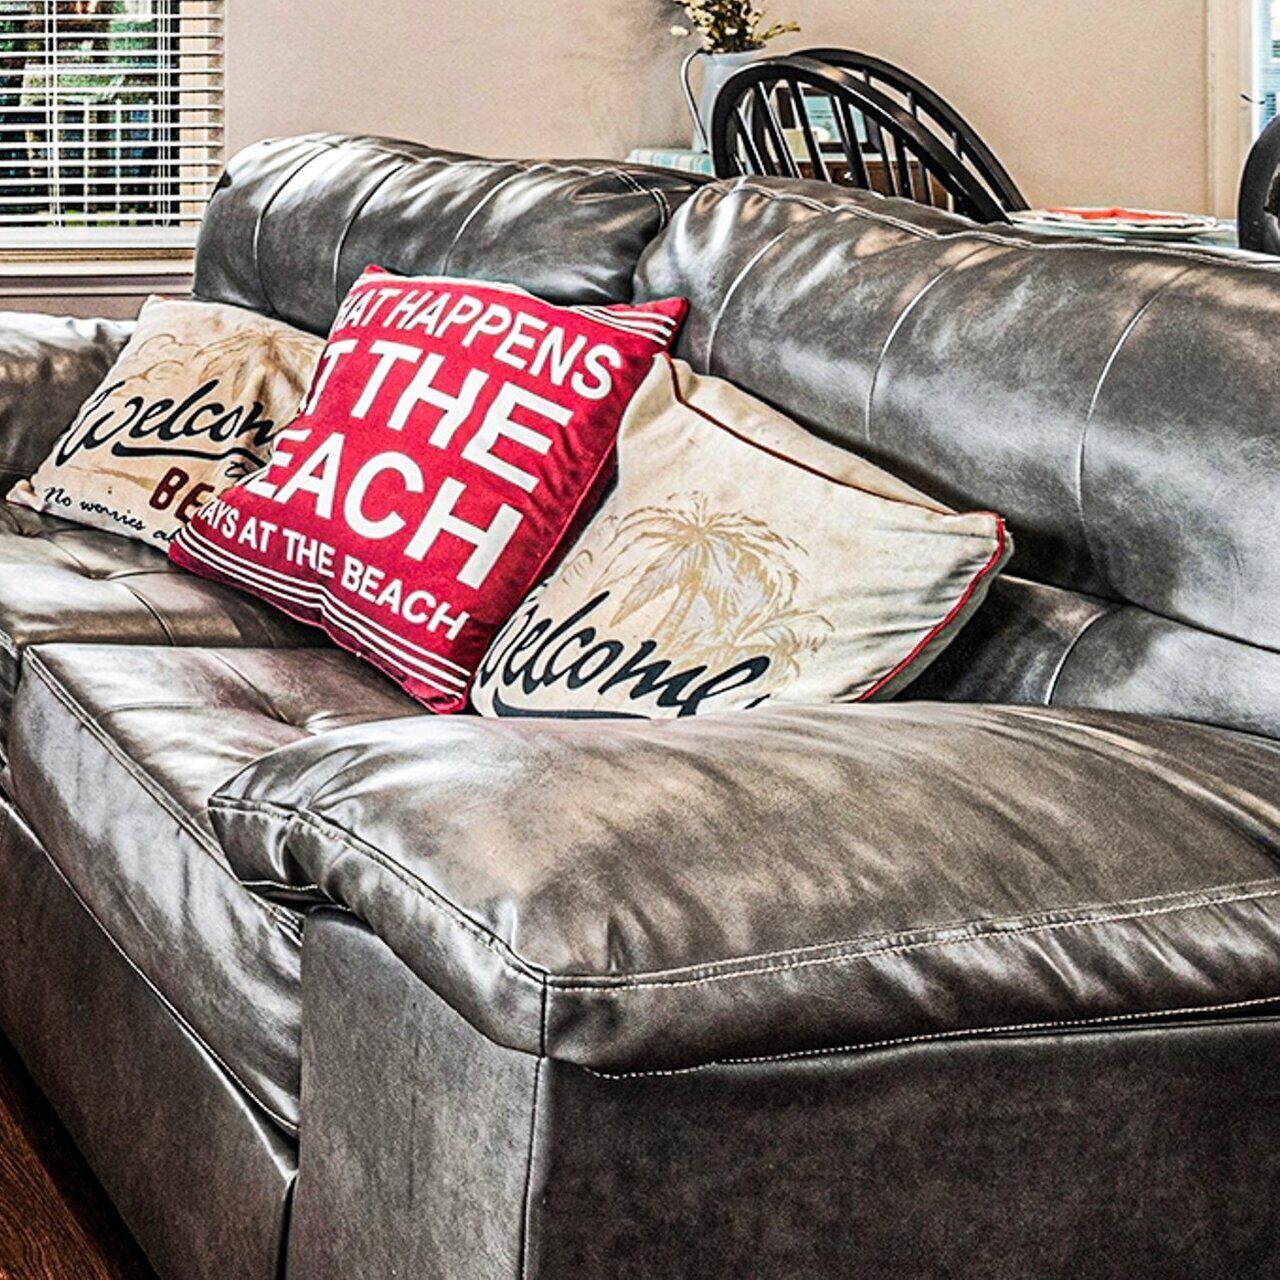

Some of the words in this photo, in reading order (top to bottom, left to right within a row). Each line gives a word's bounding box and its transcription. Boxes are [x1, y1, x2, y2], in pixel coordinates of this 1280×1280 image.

[335, 288, 401, 333] HAT
[383, 289, 623, 401] HAPPENS
[55, 379, 280, 467] Welcom
[299, 338, 359, 417] T
[350, 339, 575, 494] THE
[44, 486, 72, 507] No
[237, 428, 524, 590] EACH
[197, 498, 240, 539] AYS
[237, 516, 278, 553] AT
[282, 529, 336, 578] THE
[341, 555, 471, 641] BEACH
